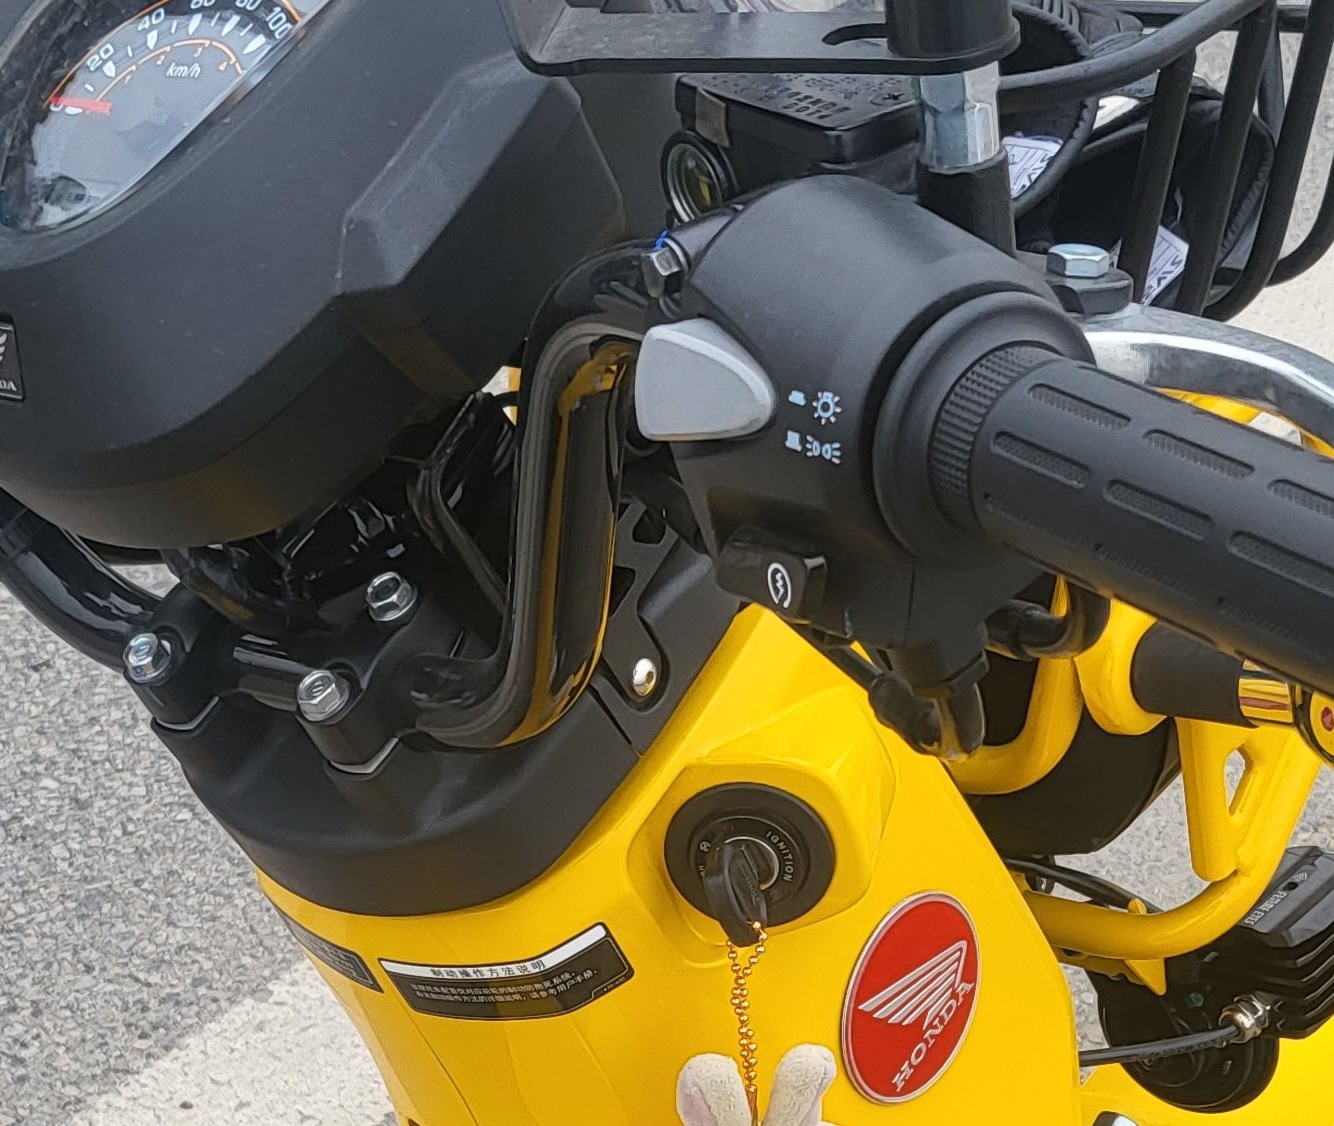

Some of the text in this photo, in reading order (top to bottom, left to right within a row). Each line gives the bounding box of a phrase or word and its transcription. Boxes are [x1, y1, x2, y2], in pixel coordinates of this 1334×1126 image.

[137, 7, 165, 31] 40
[265, 7, 293, 40] 100
[86, 43, 115, 72] 20
[166, 61, 202, 79] km/h
[765, 830, 795, 883] IGNITION
[429, 959, 546, 979] 制动操作方法说明
[890, 980, 975, 1093] HONDA
